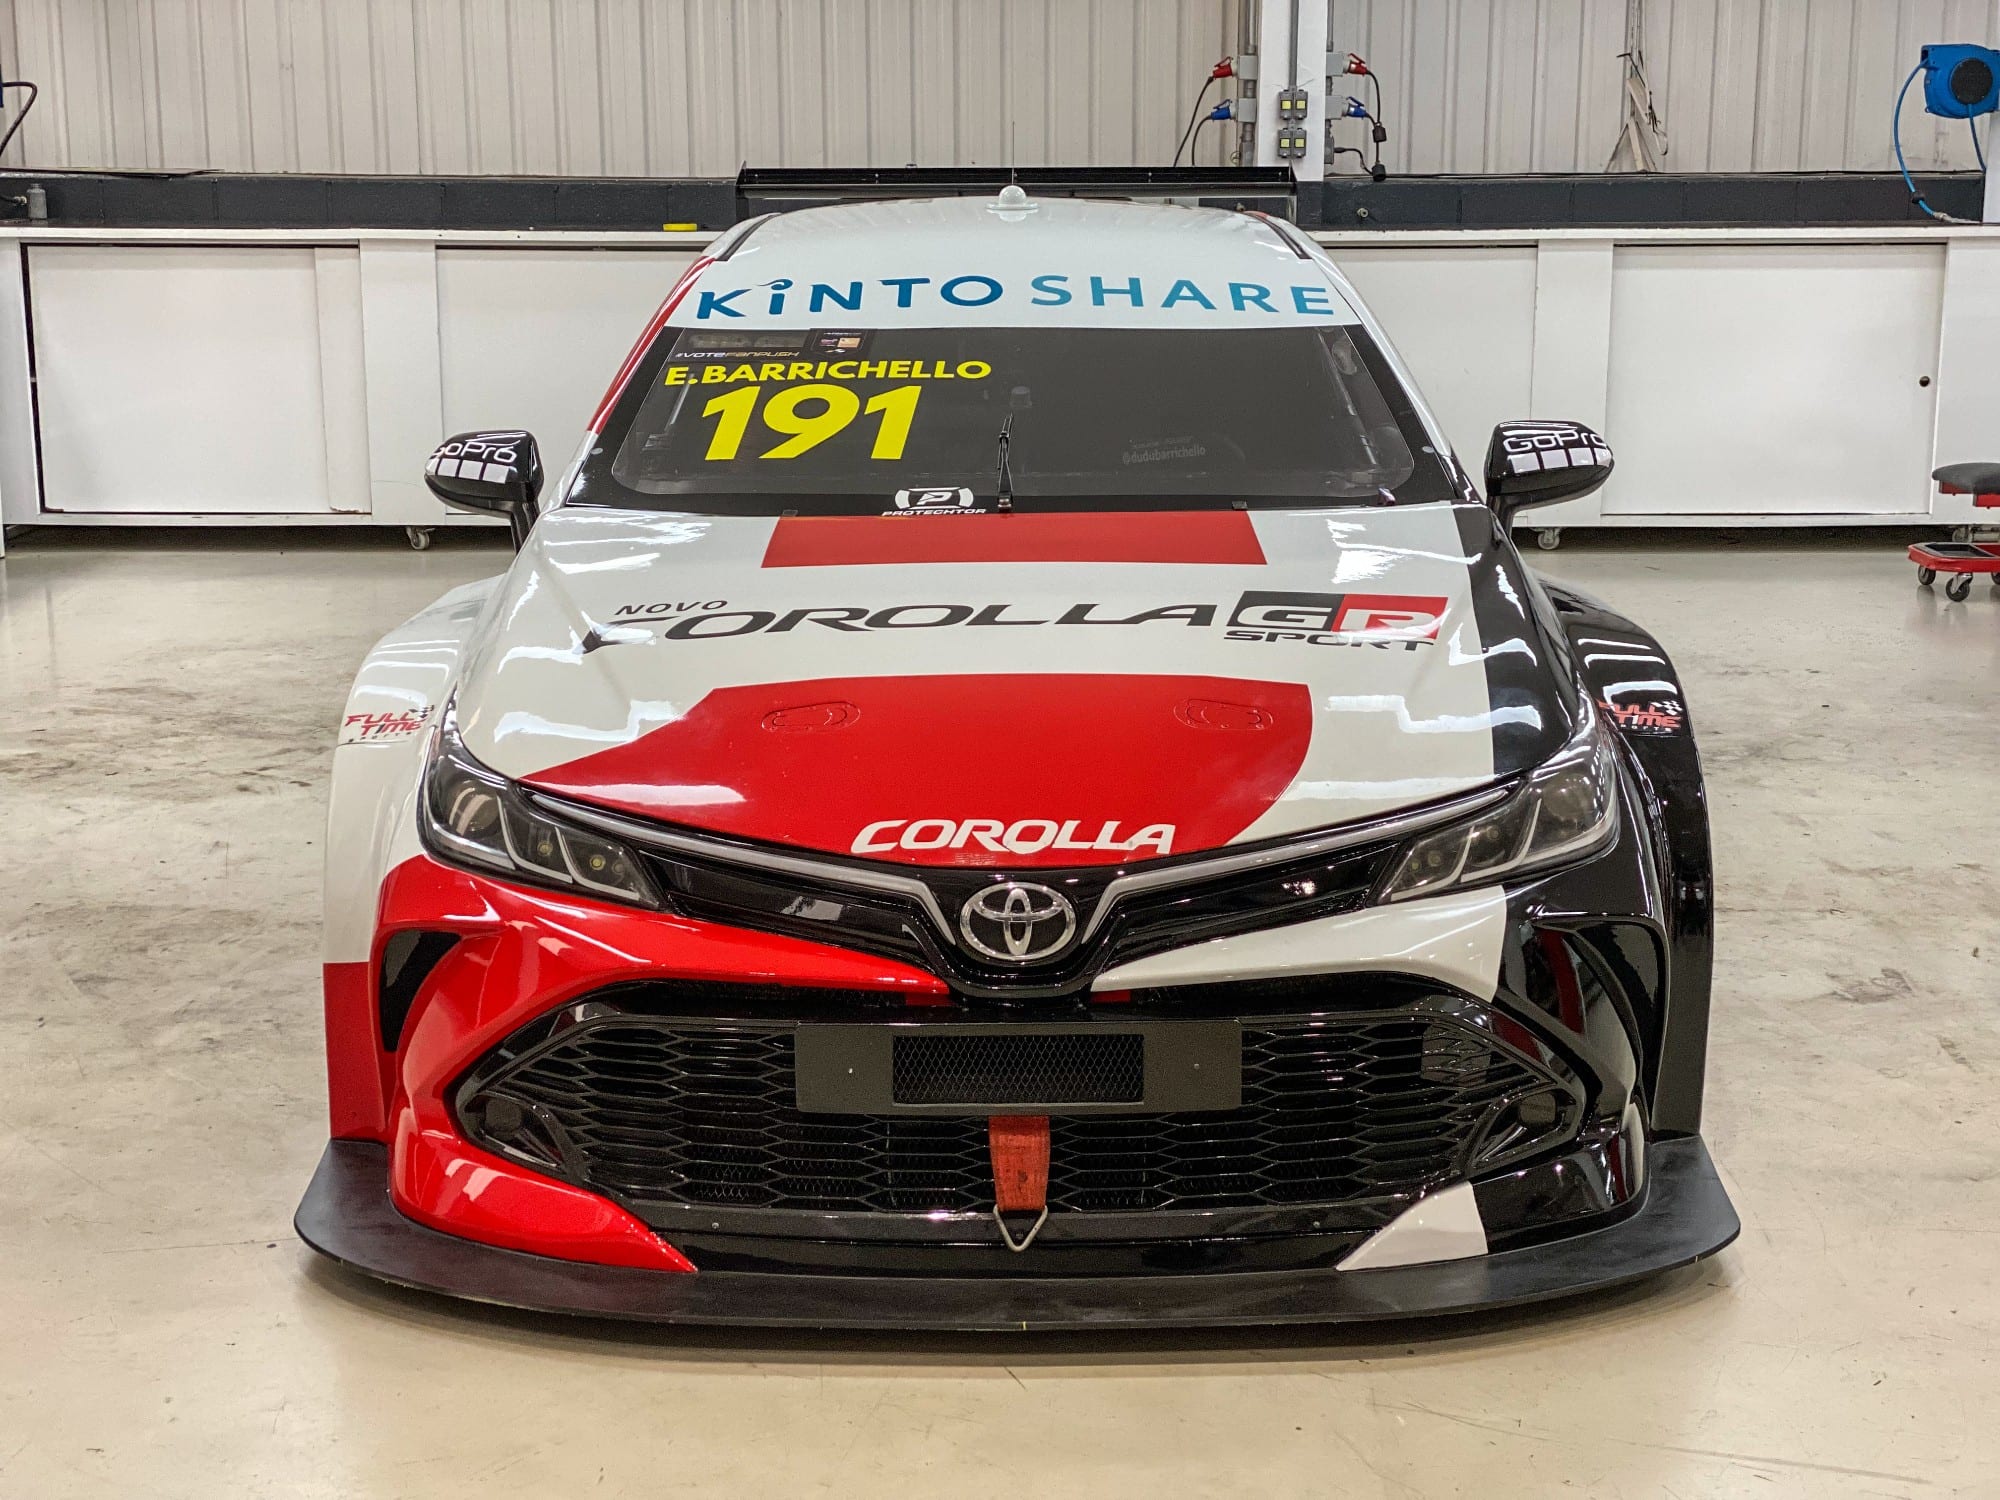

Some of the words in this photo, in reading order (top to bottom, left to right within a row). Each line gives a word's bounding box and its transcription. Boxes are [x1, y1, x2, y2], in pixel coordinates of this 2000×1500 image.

[1030, 275, 1335, 316] SHARE
[664, 360, 992, 386] E.BARRICHELLO
[701, 383, 922, 461] 191
[881, 508, 987, 517] PROTECHTOR
[614, 600, 728, 616] NOVO
[582, 603, 1218, 655] COROLLA
[344, 711, 415, 727] FULL
[850, 818, 1177, 855] COROLLA
